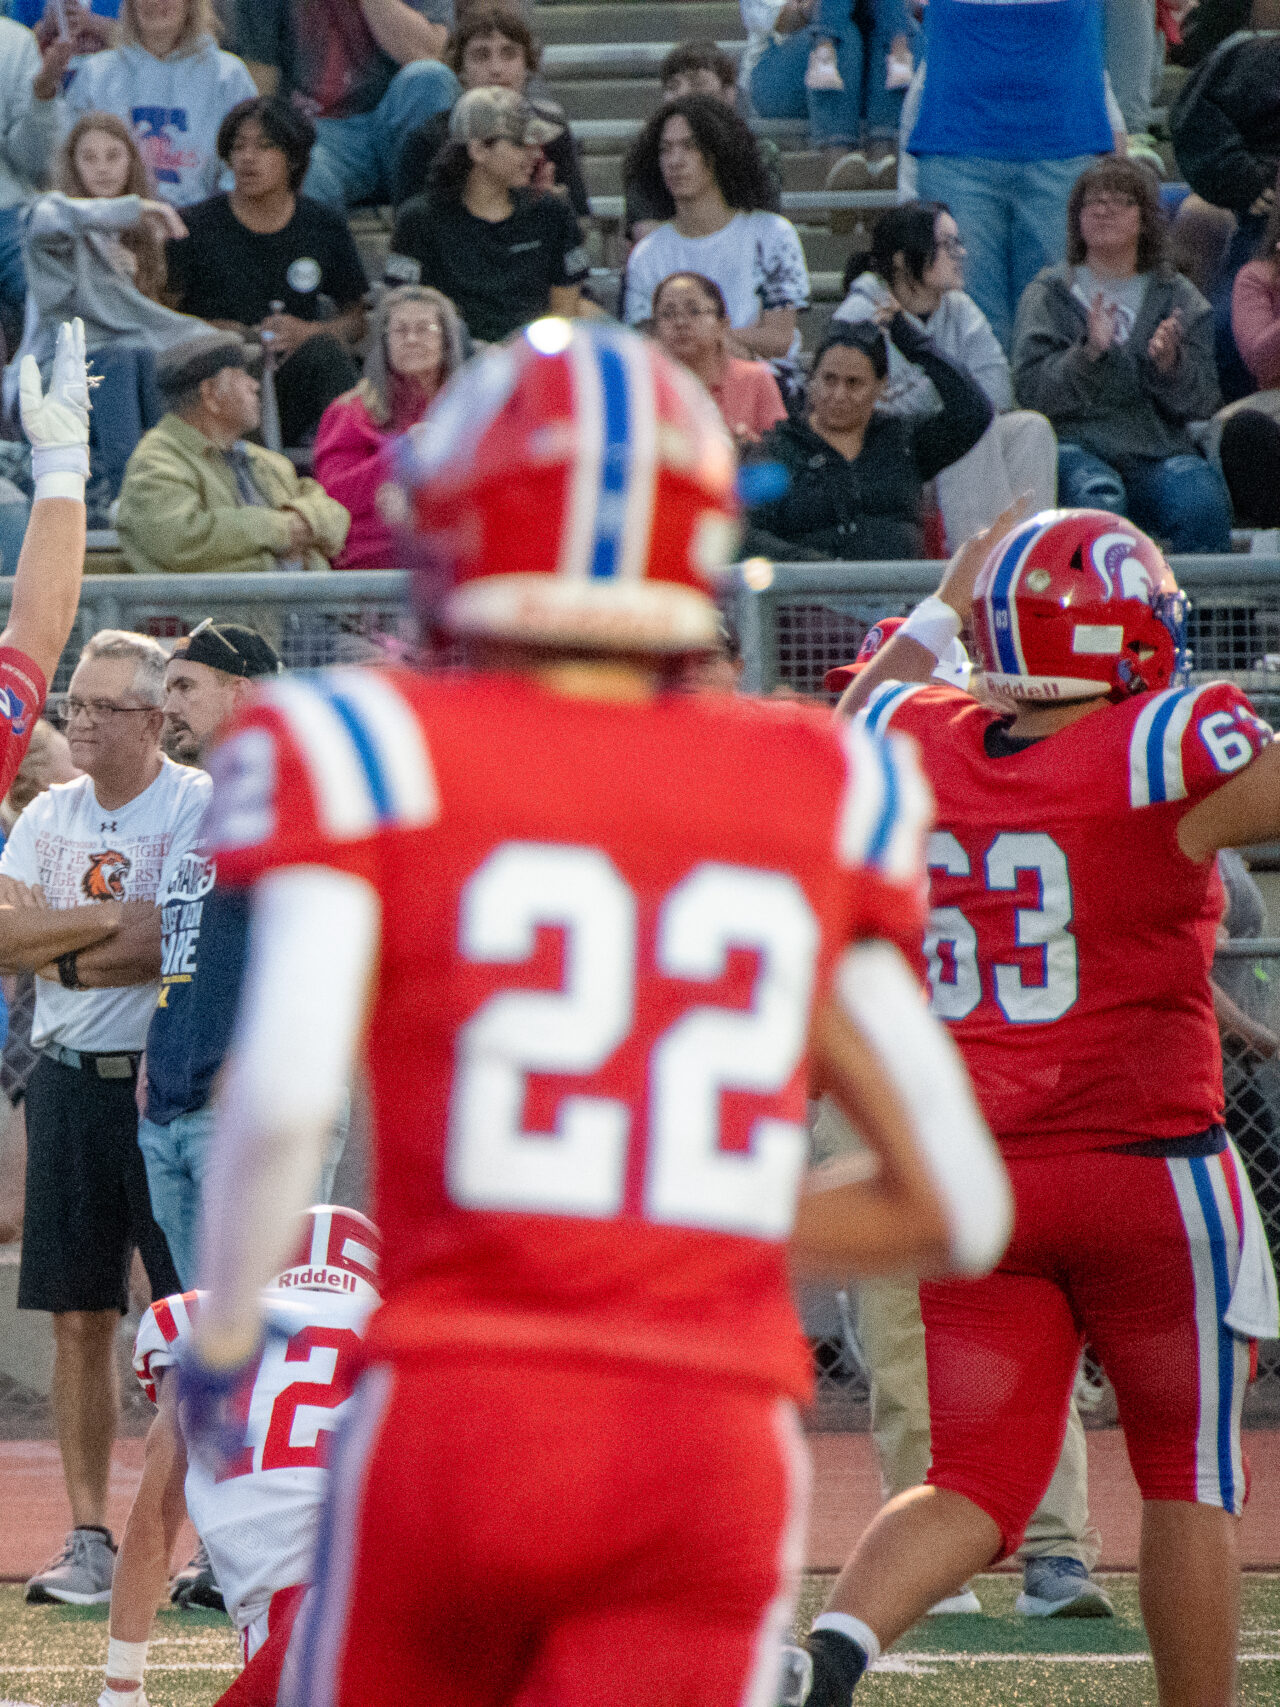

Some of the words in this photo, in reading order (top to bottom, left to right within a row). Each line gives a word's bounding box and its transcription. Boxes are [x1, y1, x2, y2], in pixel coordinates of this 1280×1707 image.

[923, 830, 1079, 1024] 63
[445, 839, 822, 1244] 22
[278, 1268, 357, 1293] Riddell
